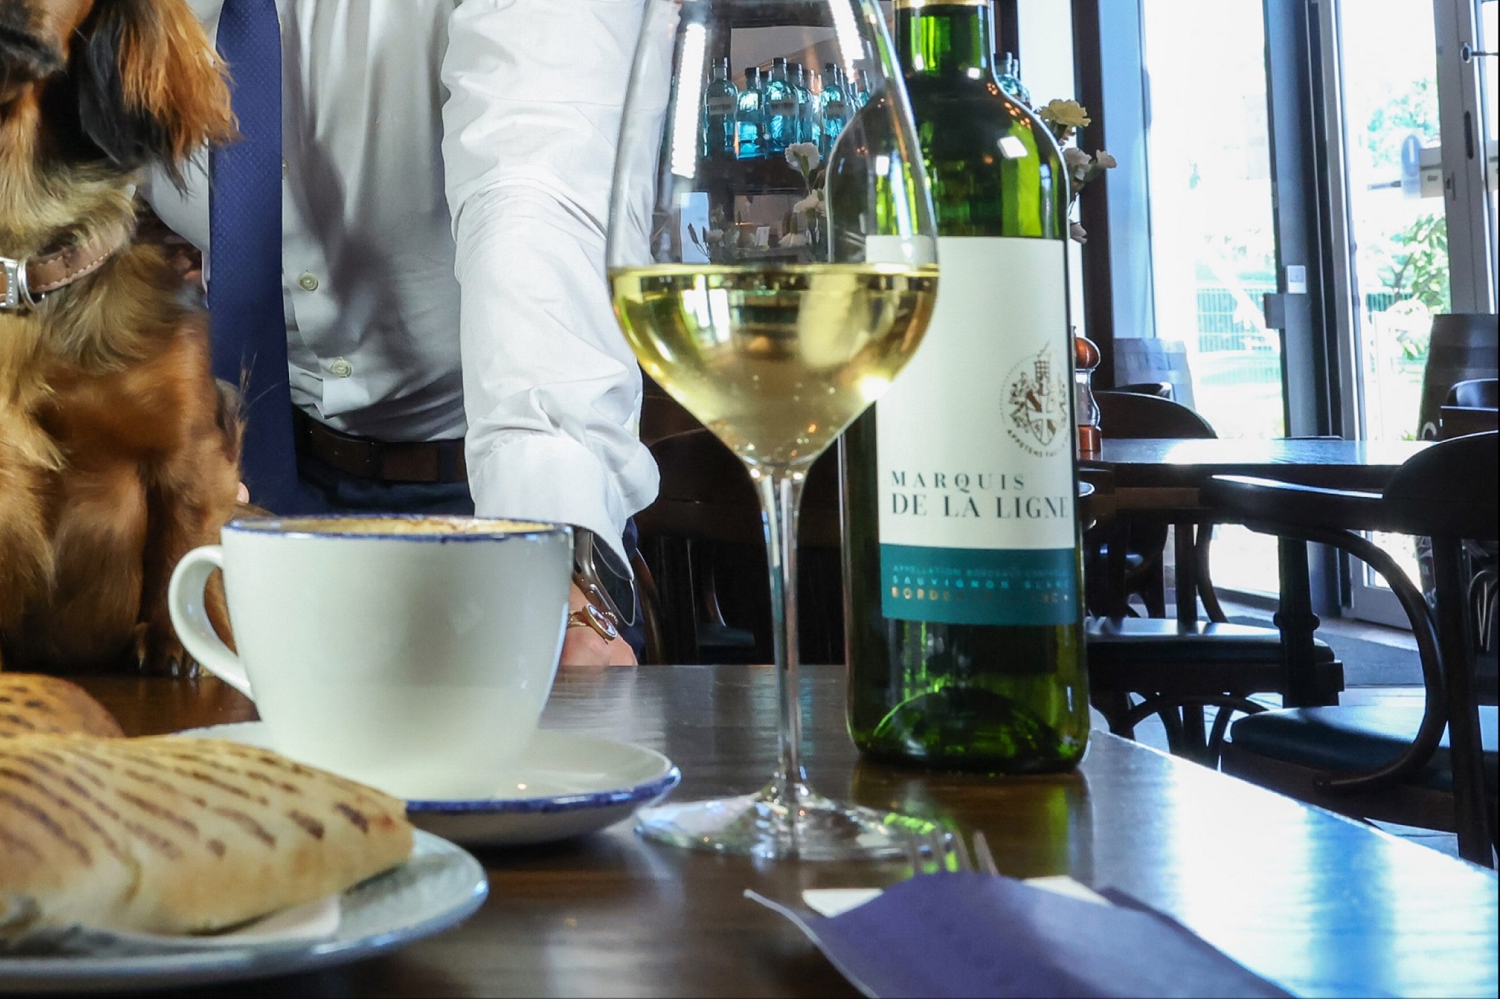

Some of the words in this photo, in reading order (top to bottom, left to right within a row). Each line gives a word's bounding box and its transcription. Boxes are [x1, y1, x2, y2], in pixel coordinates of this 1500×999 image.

[891, 470, 1024, 493] MARQUIS
[891, 493, 927, 516] DE
[944, 496, 980, 518] LA
